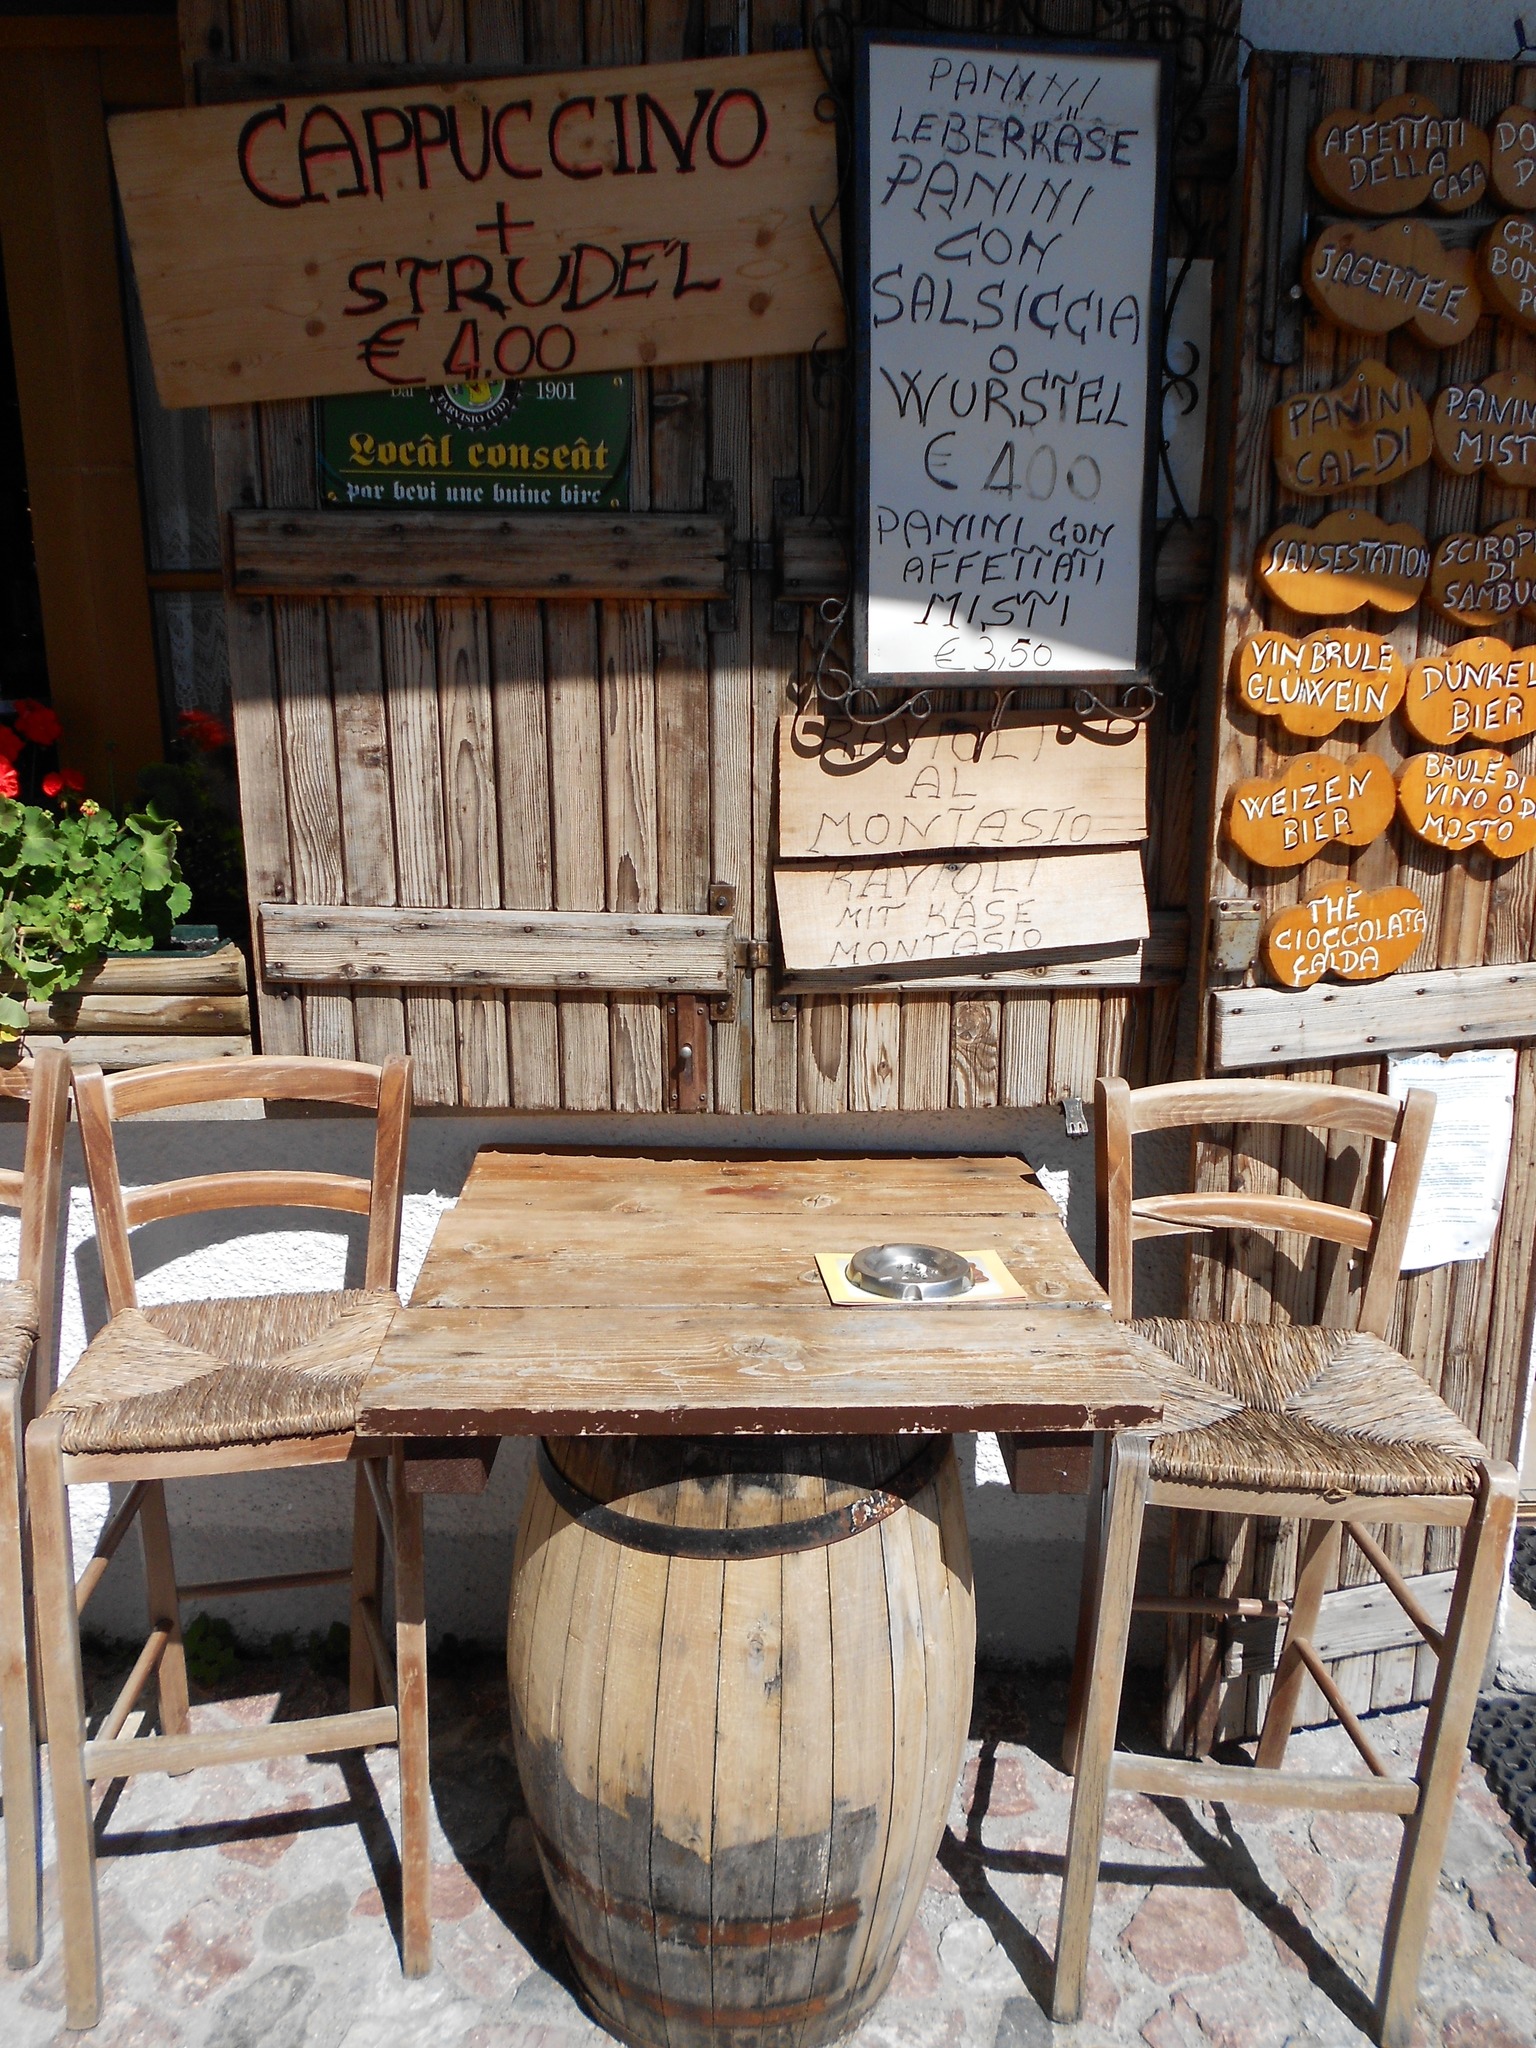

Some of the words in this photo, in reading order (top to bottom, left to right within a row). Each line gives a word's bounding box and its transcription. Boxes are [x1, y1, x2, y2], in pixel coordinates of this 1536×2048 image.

[237, 88, 768, 210] CAPPUCCINO
[1323, 113, 1466, 157] AFFETTATI
[881, 154, 1095, 226] PANINI
[1347, 147, 1447, 192] DELLA
[1432, 161, 1487, 201] CASA
[934, 221, 1062, 275] CON
[872, 263, 1141, 346] SALSICCIA
[1315, 247, 1470, 325] JAGERTEE
[356, 317, 427, 385] €
[443, 317, 576, 381] 4.00
[438, 392, 484, 424] TARVISIO
[486, 396, 511, 421] (UD)
[535, 381, 577, 401] 1901
[879, 366, 1129, 429] WURSTEL
[1287, 381, 1415, 440] PANINI
[348, 432, 454, 469] Locâl
[467, 436, 610, 472] conseât
[924, 431, 958, 490] €
[1295, 425, 1412, 486] CALDI
[346, 481, 385, 503] par
[393, 481, 437, 503] bevi
[446, 485, 485, 503] une
[493, 482, 552, 505] buine
[560, 482, 603, 505] bire
[877, 505, 1024, 549] PANINI
[1050, 516, 1115, 548] CON
[902, 544, 1106, 585] AFFETTATI
[1440, 531, 1536, 567] SCIROP
[1484, 560, 1516, 584] DI
[913, 590, 1070, 632] MISTI
[1443, 581, 1536, 613] SAMBU
[934, 637, 966, 671] €
[973, 636, 1053, 672] 3,50
[1251, 639, 1306, 669] VIN
[1309, 640, 1394, 675] BRULE
[1446, 695, 1524, 737] BIER
[905, 765, 978, 800] AL
[1239, 769, 1373, 821] WEIZEN
[1424, 782, 1489, 810] VINO
[1504, 770, 1528, 795] DI
[807, 804, 1093, 854] MONTASIO
[1283, 807, 1353, 851] BIER
[1418, 811, 1514, 847] MOSTO
[826, 855, 1043, 901] RAVIOLI
[835, 903, 906, 930] MIT
[928, 896, 1036, 931] KÄSE
[1306, 889, 1363, 925] THE
[829, 927, 1043, 968] MONTASIO
[1275, 908, 1428, 951] CIOCCOLATA
[1292, 945, 1380, 984] CALDA
